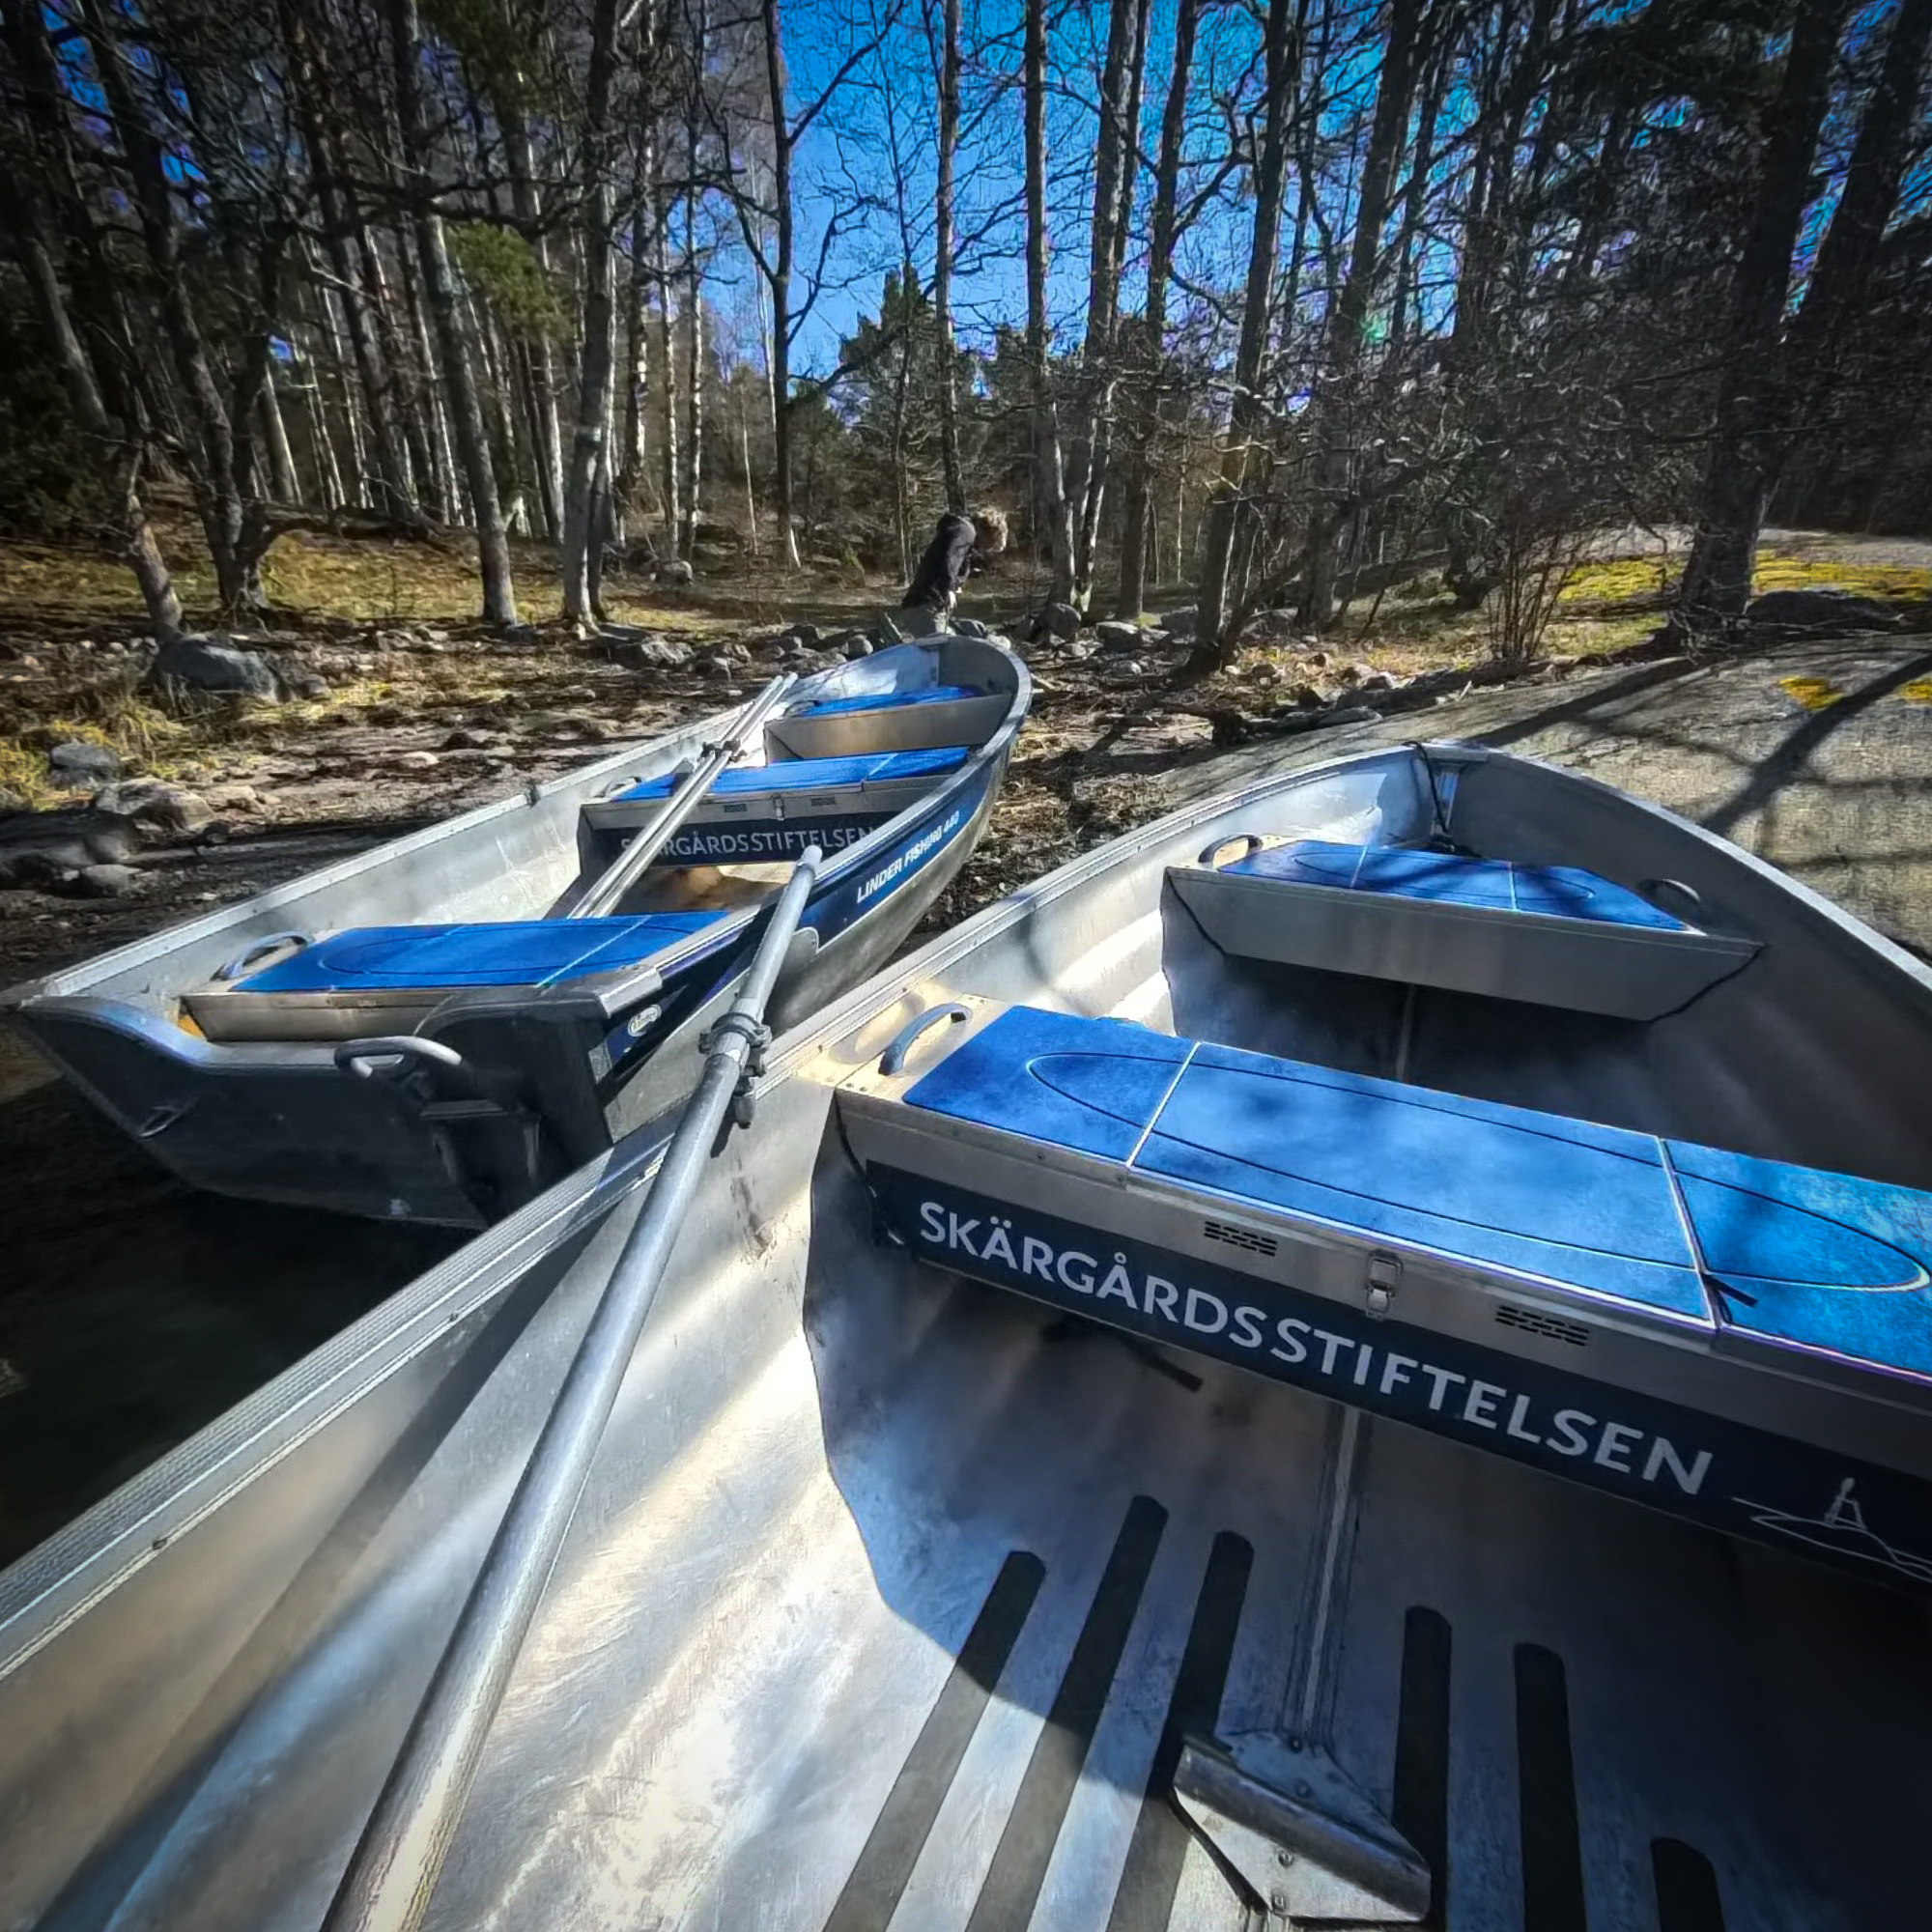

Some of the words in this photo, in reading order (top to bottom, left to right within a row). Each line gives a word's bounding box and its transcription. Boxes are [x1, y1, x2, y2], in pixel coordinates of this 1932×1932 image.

[621, 827, 874, 856] SRGÅRDSSTIFTELSE
[857, 858, 902, 903] LINDER
[921, 1202, 1713, 1495] SKÄRGÅRDSSTIFTELSEN
